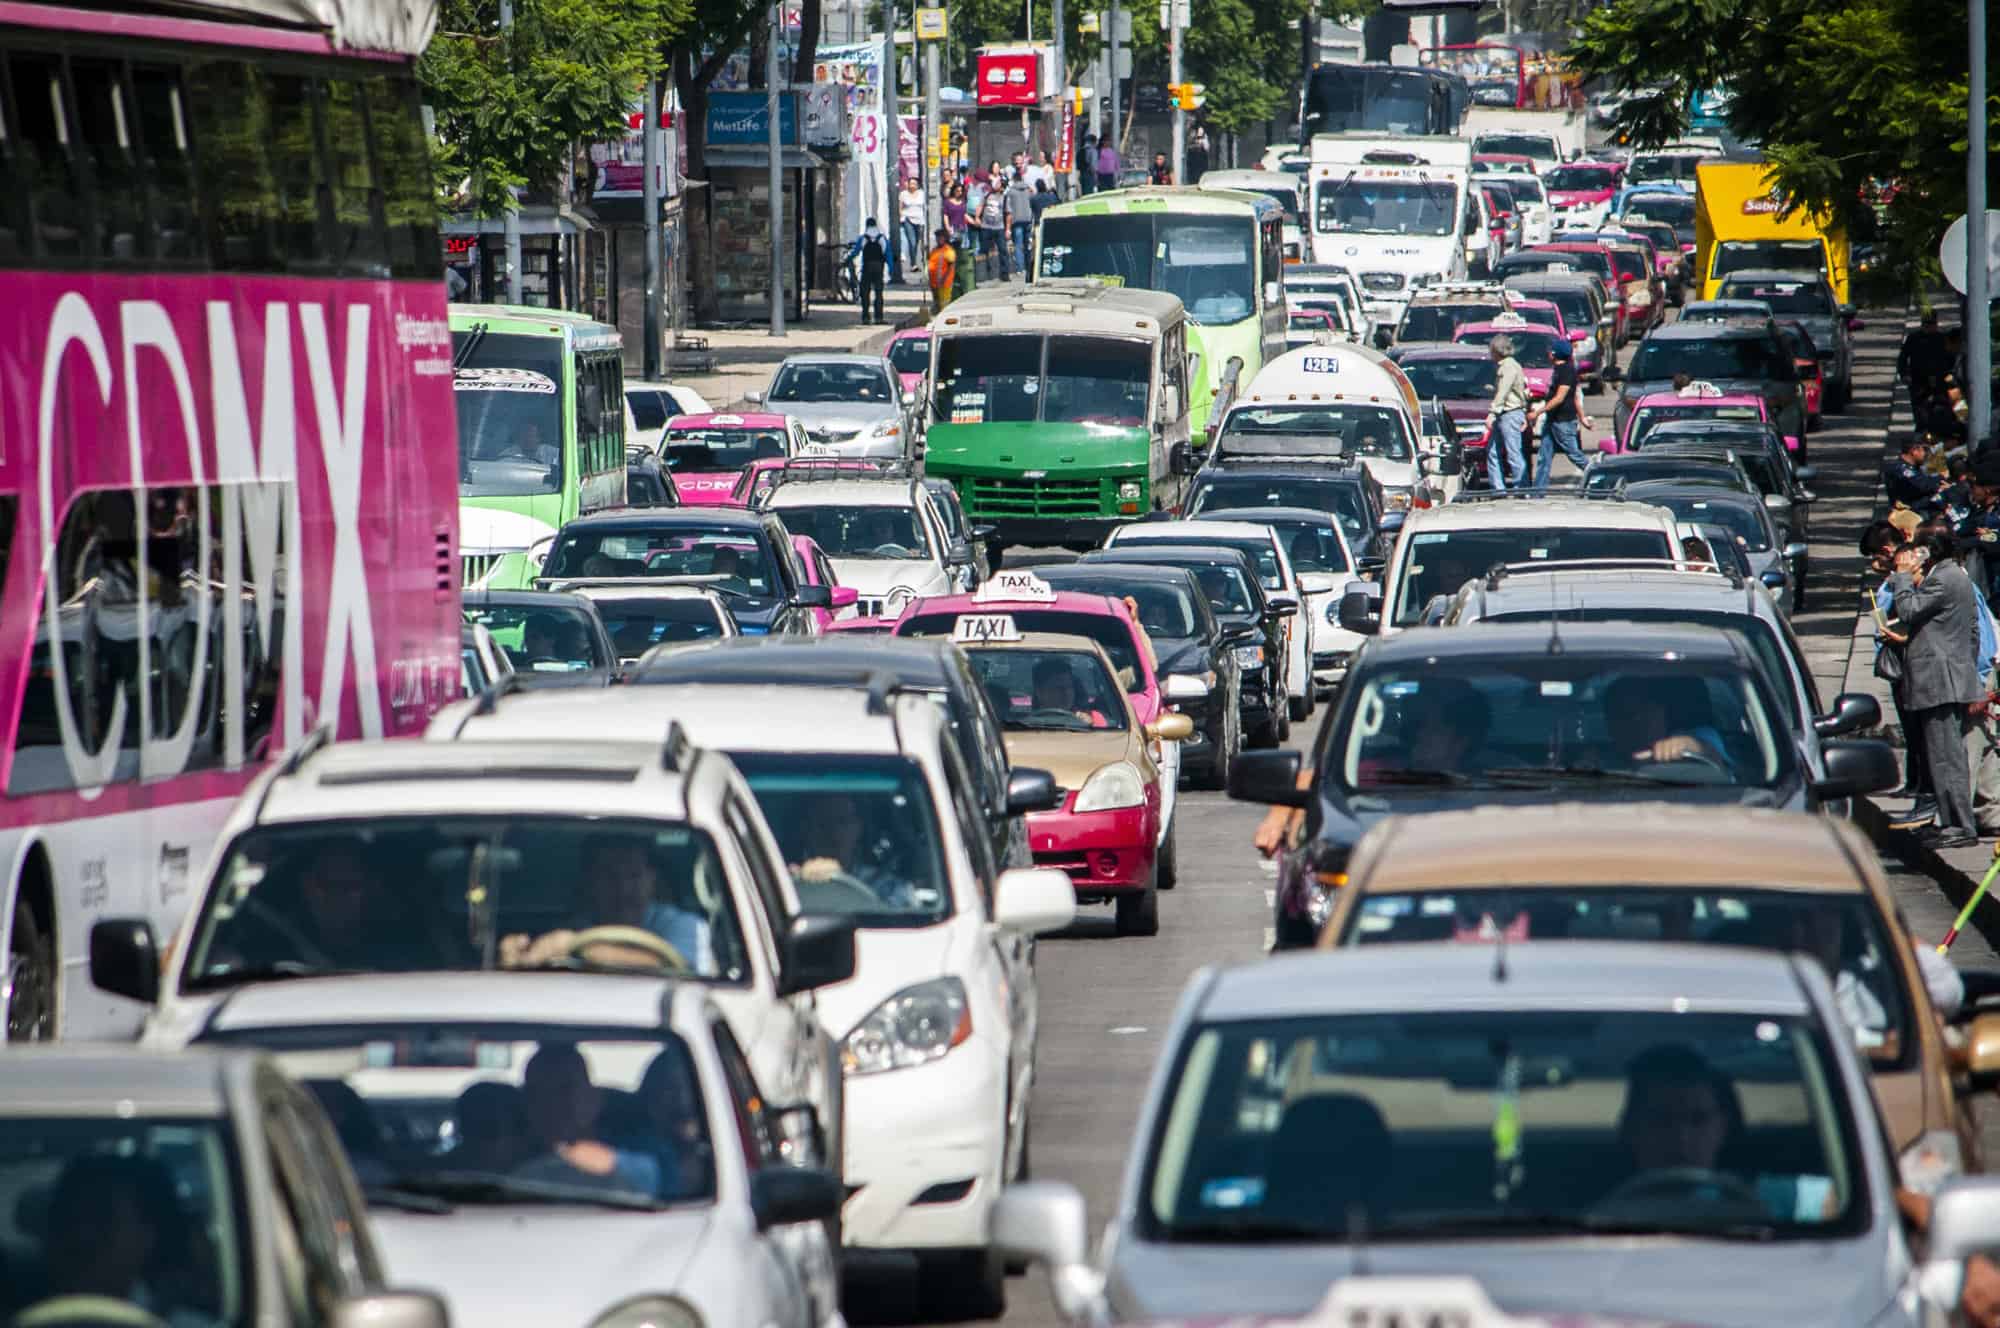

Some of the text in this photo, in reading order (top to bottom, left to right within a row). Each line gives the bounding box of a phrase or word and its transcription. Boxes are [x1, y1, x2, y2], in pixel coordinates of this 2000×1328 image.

[713, 120, 760, 132] MetLife
[852, 115, 878, 153] 43
[807, 446, 827, 455] TAXI
[679, 481, 734, 491] CDM
[39, 291, 383, 799] CDMX
[1000, 576, 1031, 587] TAXI
[963, 618, 1007, 638] TAXI
